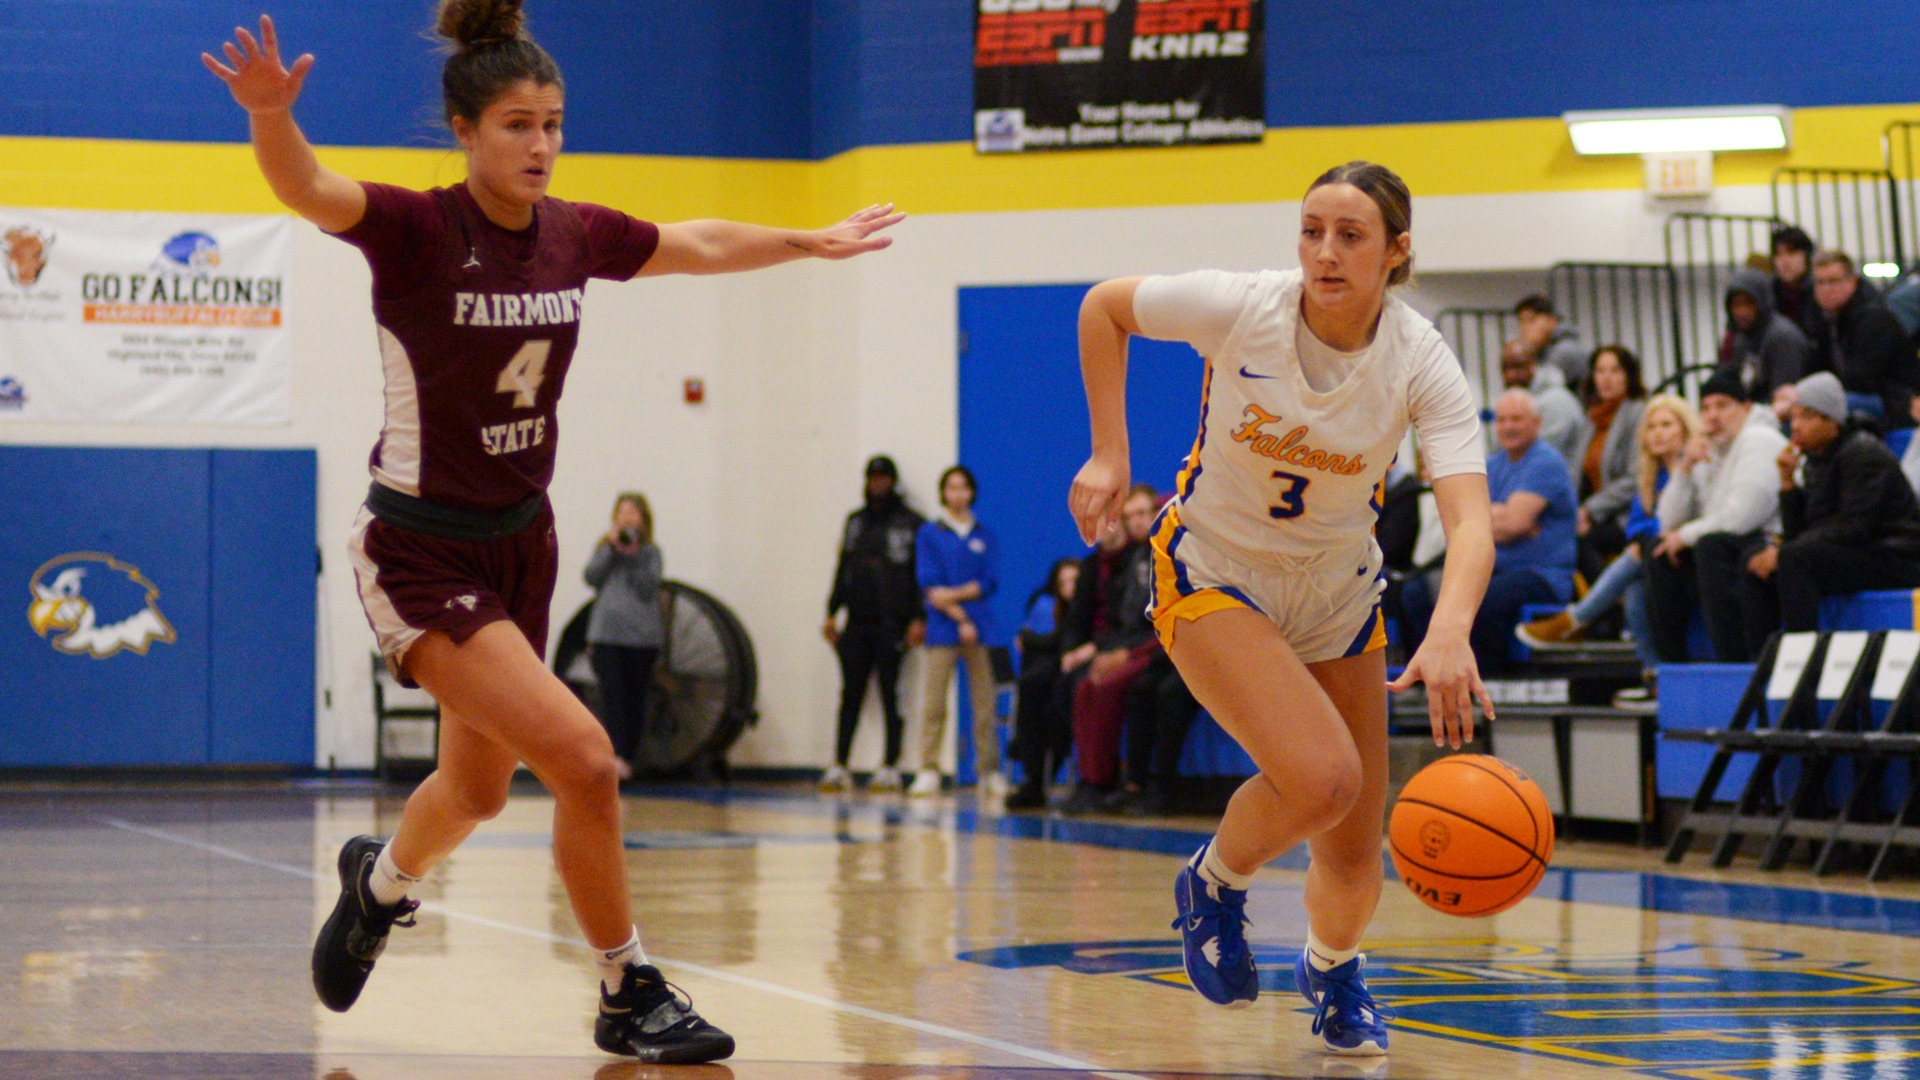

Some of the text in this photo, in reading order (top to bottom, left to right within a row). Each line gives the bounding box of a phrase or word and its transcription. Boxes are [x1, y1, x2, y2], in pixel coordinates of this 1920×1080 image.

[977, 7, 1105, 50] ESPN
[1134, 0, 1249, 36] ESPN
[82, 273, 282, 305] GO FALCONS!
[495, 339, 552, 408] 4
[481, 415, 546, 456] STATE
[1230, 403, 1367, 475] Falcons
[1268, 470, 1311, 520] 3
